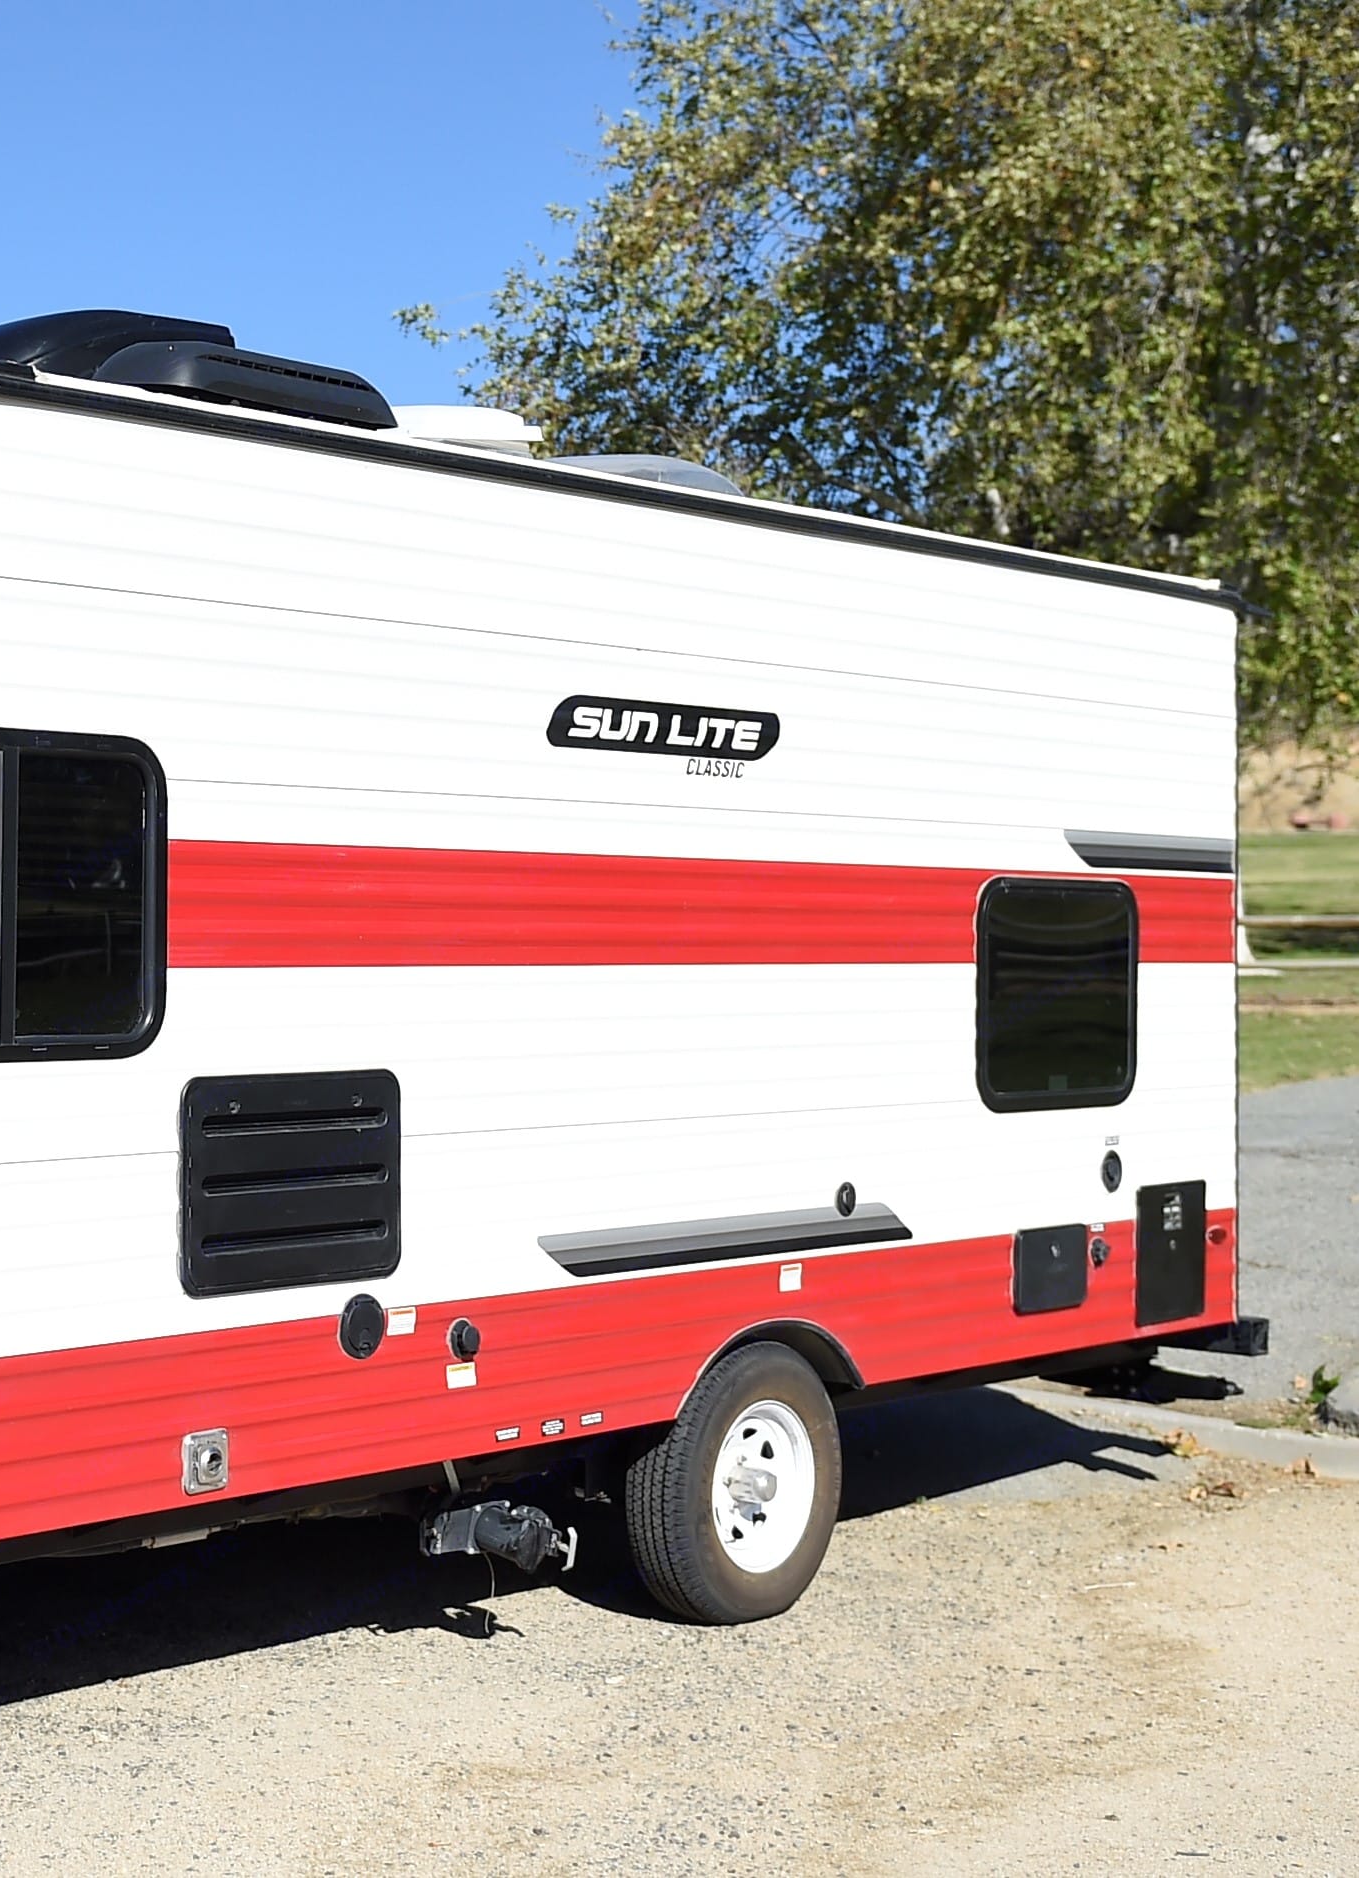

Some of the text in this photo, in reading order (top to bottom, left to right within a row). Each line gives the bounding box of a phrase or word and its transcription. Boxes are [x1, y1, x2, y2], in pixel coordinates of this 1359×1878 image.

[567, 706, 763, 752] SUN LITE
[686, 758, 745, 779] CLASSIC
